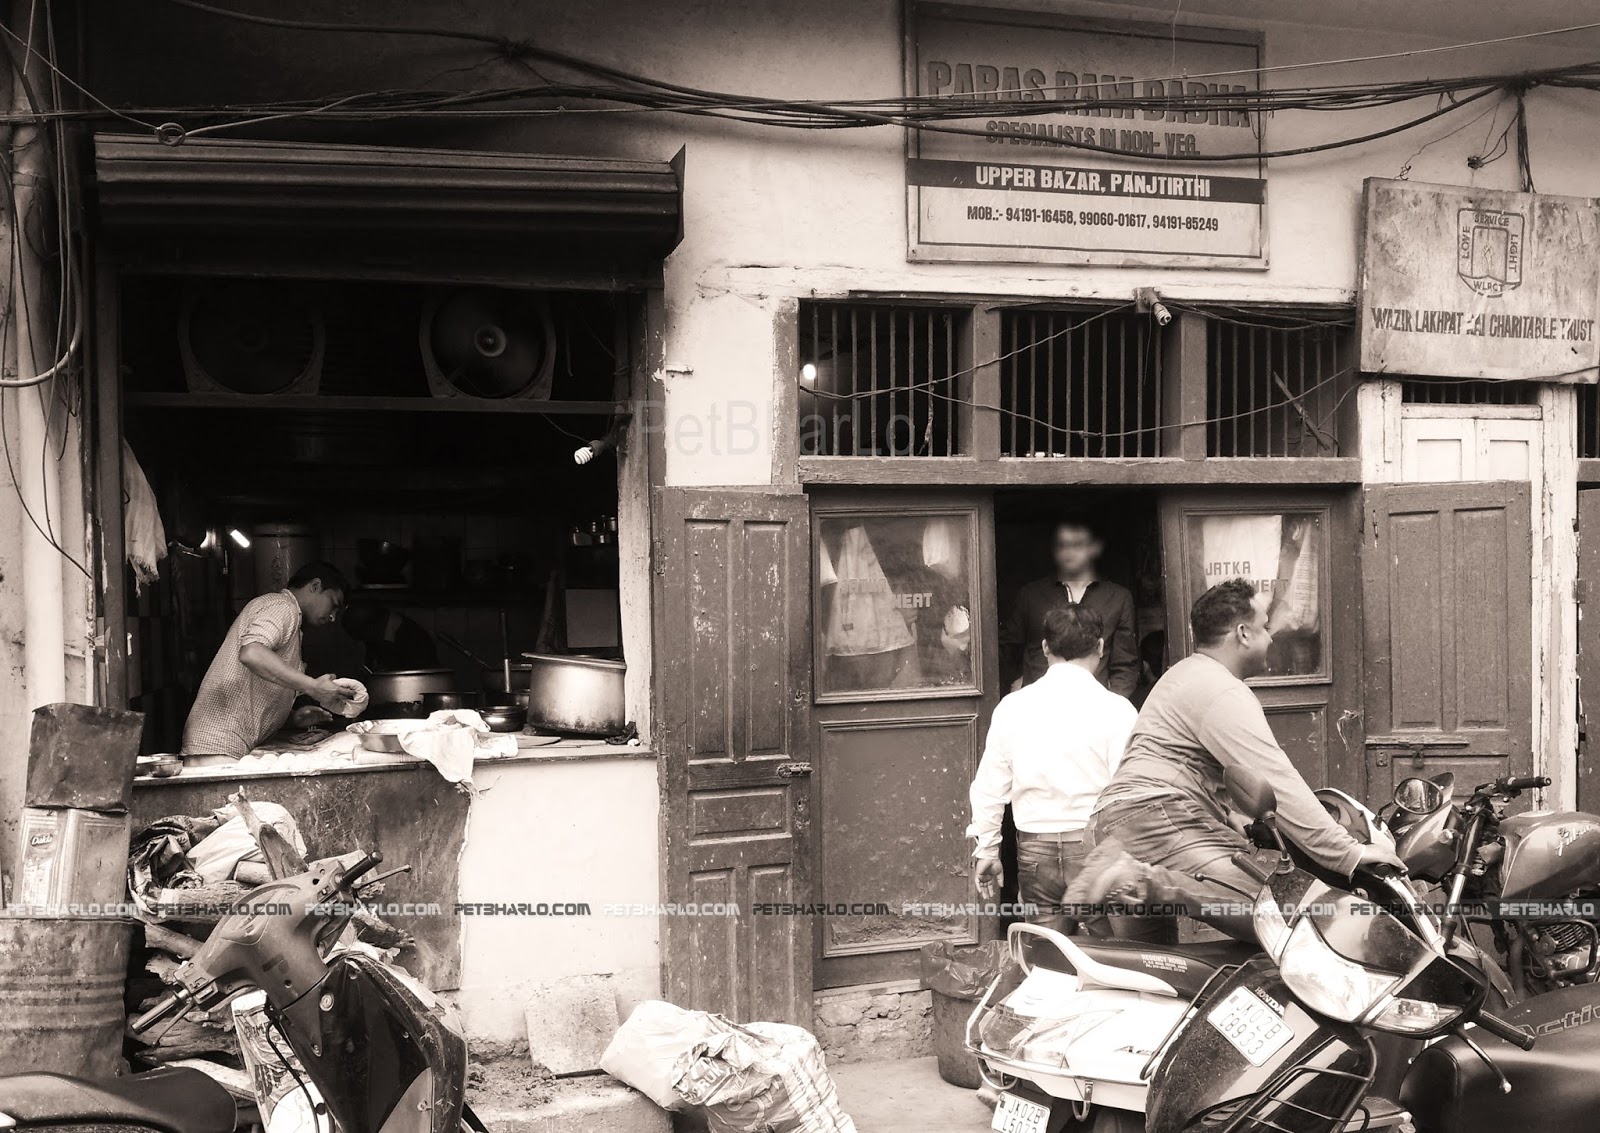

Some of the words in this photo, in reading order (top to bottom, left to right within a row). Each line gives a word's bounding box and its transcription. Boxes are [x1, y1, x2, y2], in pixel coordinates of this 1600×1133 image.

[927, 60, 1047, 105] PARAS
[1055, 70, 1135, 119] RAM
[985, 120, 1097, 149] SPECIALISTS
[1100, 127, 1117, 150] IN
[1120, 129, 1160, 154] NON-
[975, 165, 1036, 188] UPPER
[1040, 169, 1106, 194] BAZAR,
[1110, 173, 1211, 198] PANJTIRTHI
[1005, 207, 1077, 226] 94191-16458,
[1079, 211, 1151, 229] 99060-01617,
[1152, 215, 1219, 232] 94191-85249
[1474, 212, 1510, 227] SERVICE
[1461, 225, 1471, 260] LOVE
[1508, 234, 1519, 273] LIGHT
[1473, 280, 1504, 292] WLRCT
[1372, 307, 1413, 333] WAZIR
[1415, 310, 1464, 335] LAKHPAT
[1489, 314, 1557, 340] CHARITABLE
[1205, 561, 1251, 576] JATKA
[1254, 986, 1286, 1017] HONDA
[1236, 1000, 1283, 1040] JK02B
[1008, 1099, 1042, 1125] JK02B
